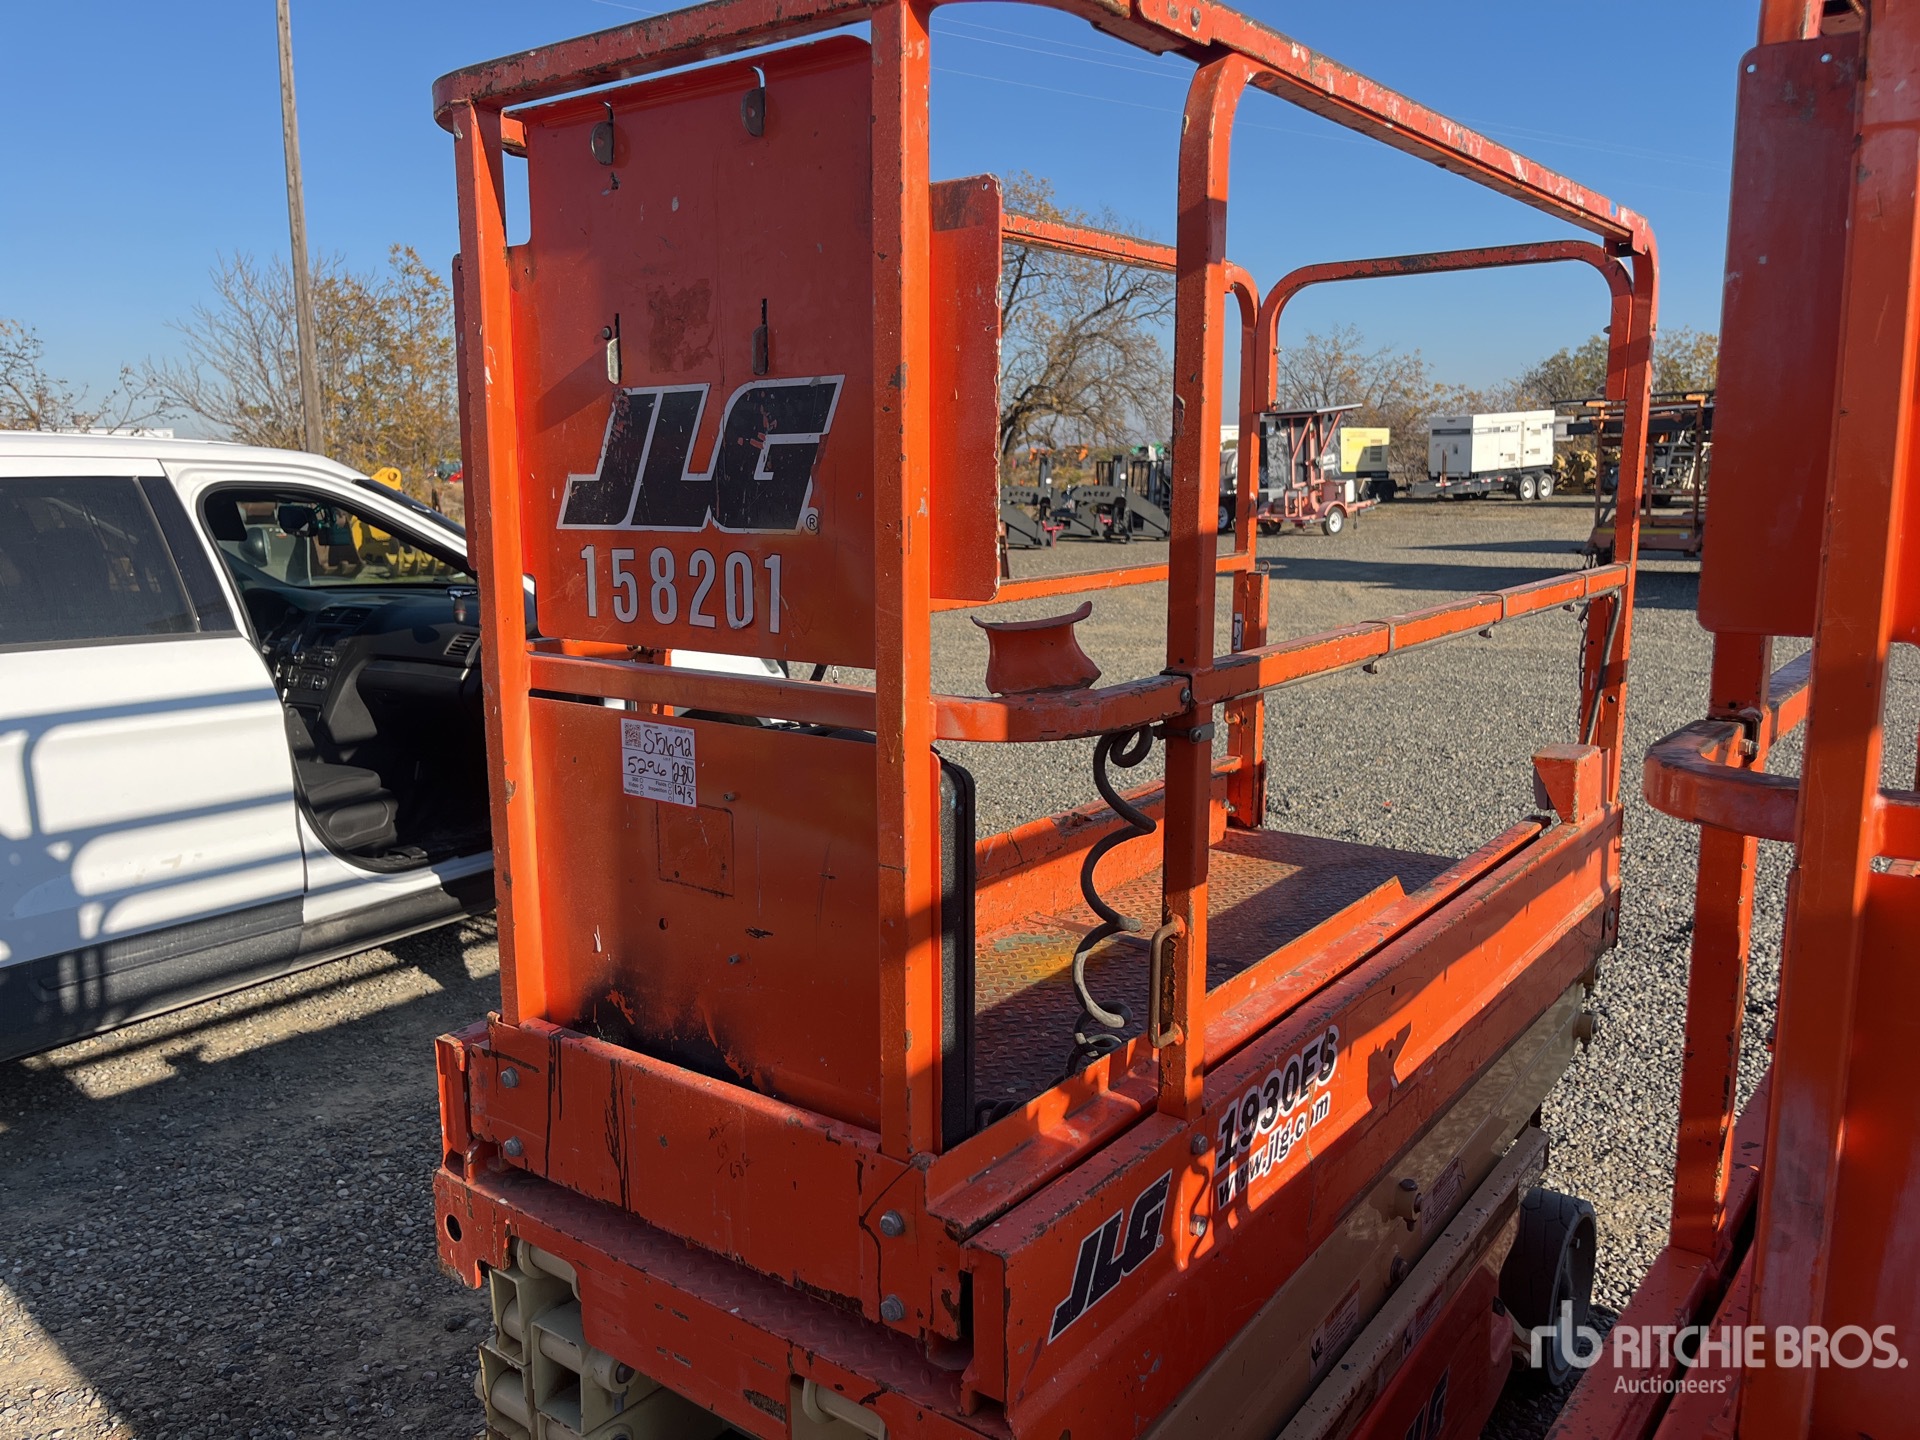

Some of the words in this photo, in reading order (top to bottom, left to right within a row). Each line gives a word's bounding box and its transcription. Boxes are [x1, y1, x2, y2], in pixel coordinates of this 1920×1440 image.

[580, 544, 782, 633] 158201
[628, 756, 667, 776] 5296
[1215, 1028, 1338, 1171] 1930ES
